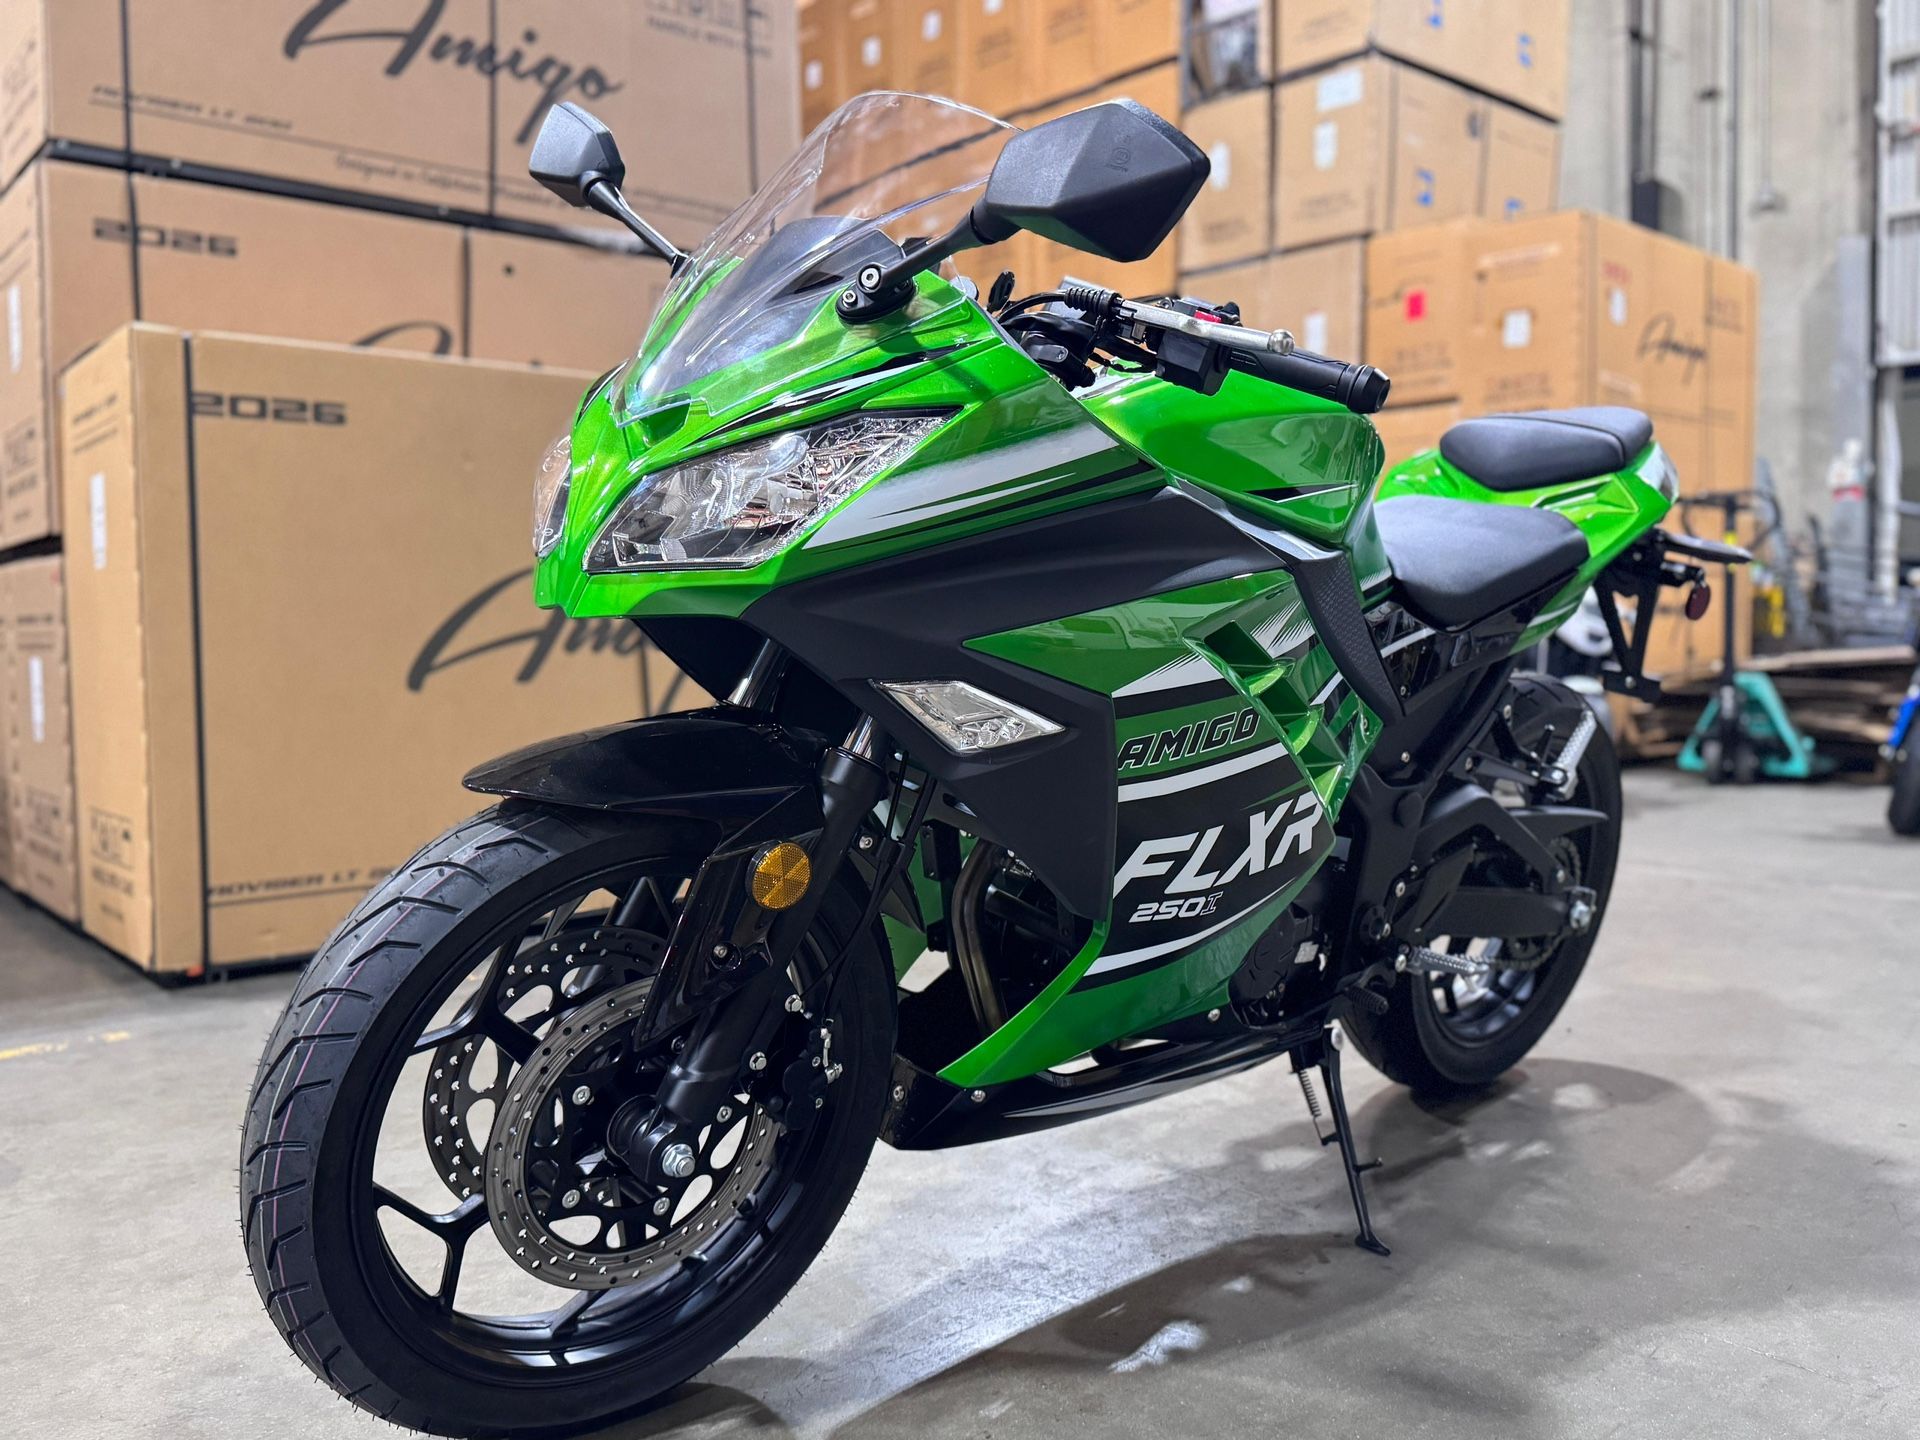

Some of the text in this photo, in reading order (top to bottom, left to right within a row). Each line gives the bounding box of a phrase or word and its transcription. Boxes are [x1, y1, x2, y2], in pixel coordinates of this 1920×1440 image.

[283, 0, 624, 145] Amigo
[93, 216, 238, 258] 2026
[191, 390, 347, 427] 2026
[1117, 707, 1260, 771] AMIGO
[1112, 791, 1323, 899] FLXR
